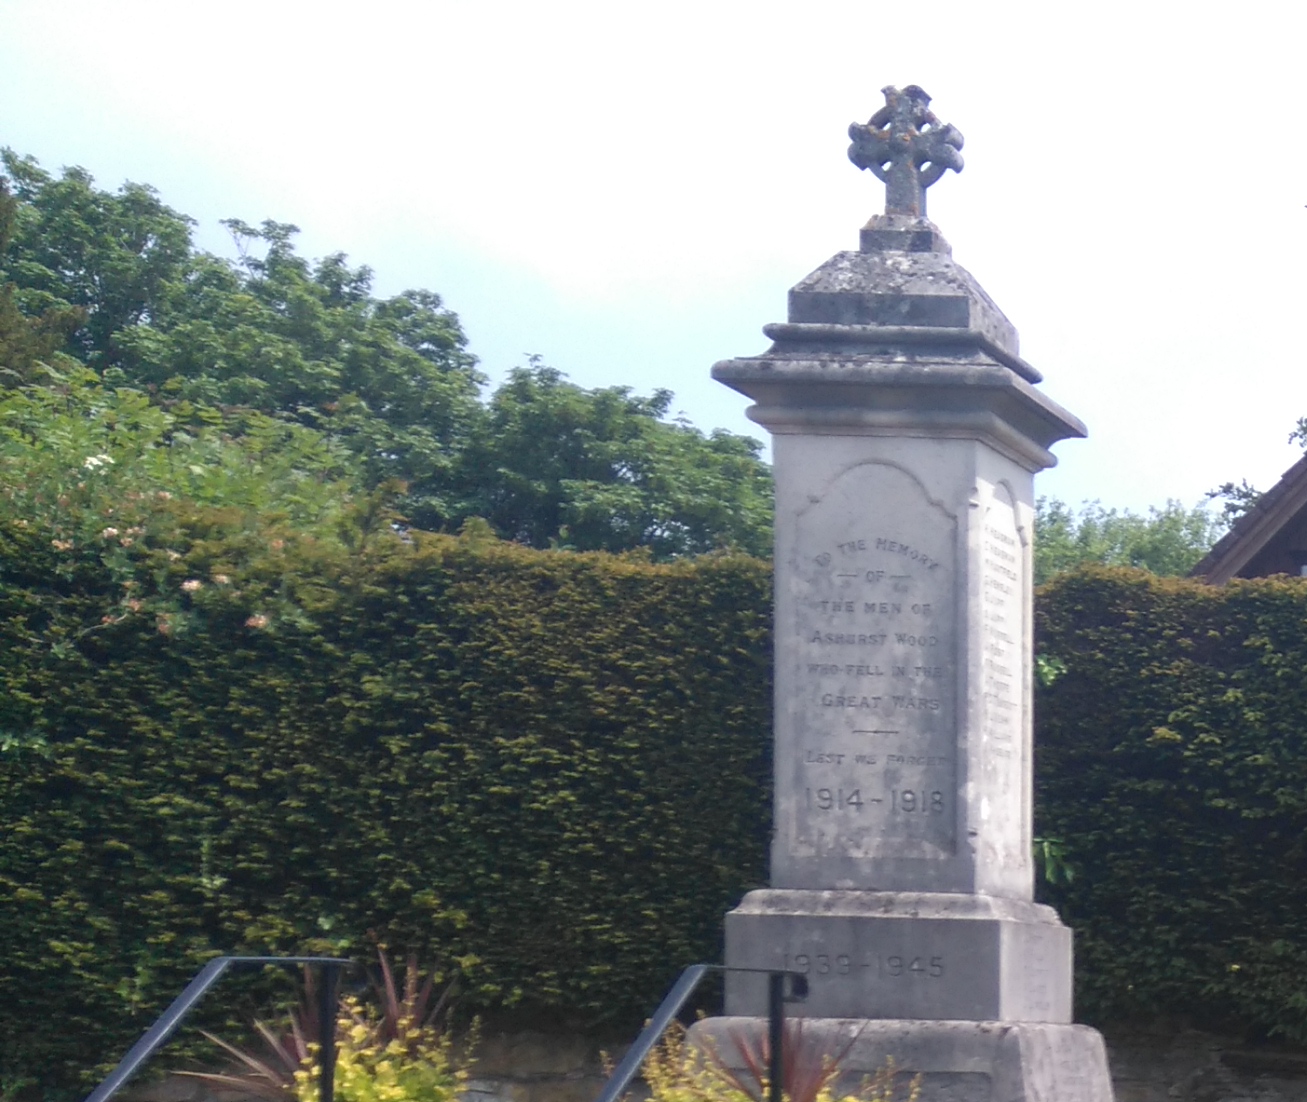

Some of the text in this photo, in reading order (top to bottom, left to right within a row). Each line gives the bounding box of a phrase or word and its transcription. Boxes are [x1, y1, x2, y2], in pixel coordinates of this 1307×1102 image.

[837, 539, 867, 555] THE
[875, 537, 939, 570] MEMORY
[866, 570, 885, 583] OF
[822, 601, 931, 615] THE MEN OF
[847, 664, 884, 676] FELL
[891, 666, 906, 676] IN
[914, 666, 942, 677] THE
[821, 693, 940, 711] GREAT WARS
[886, 754, 949, 766] FORGET
